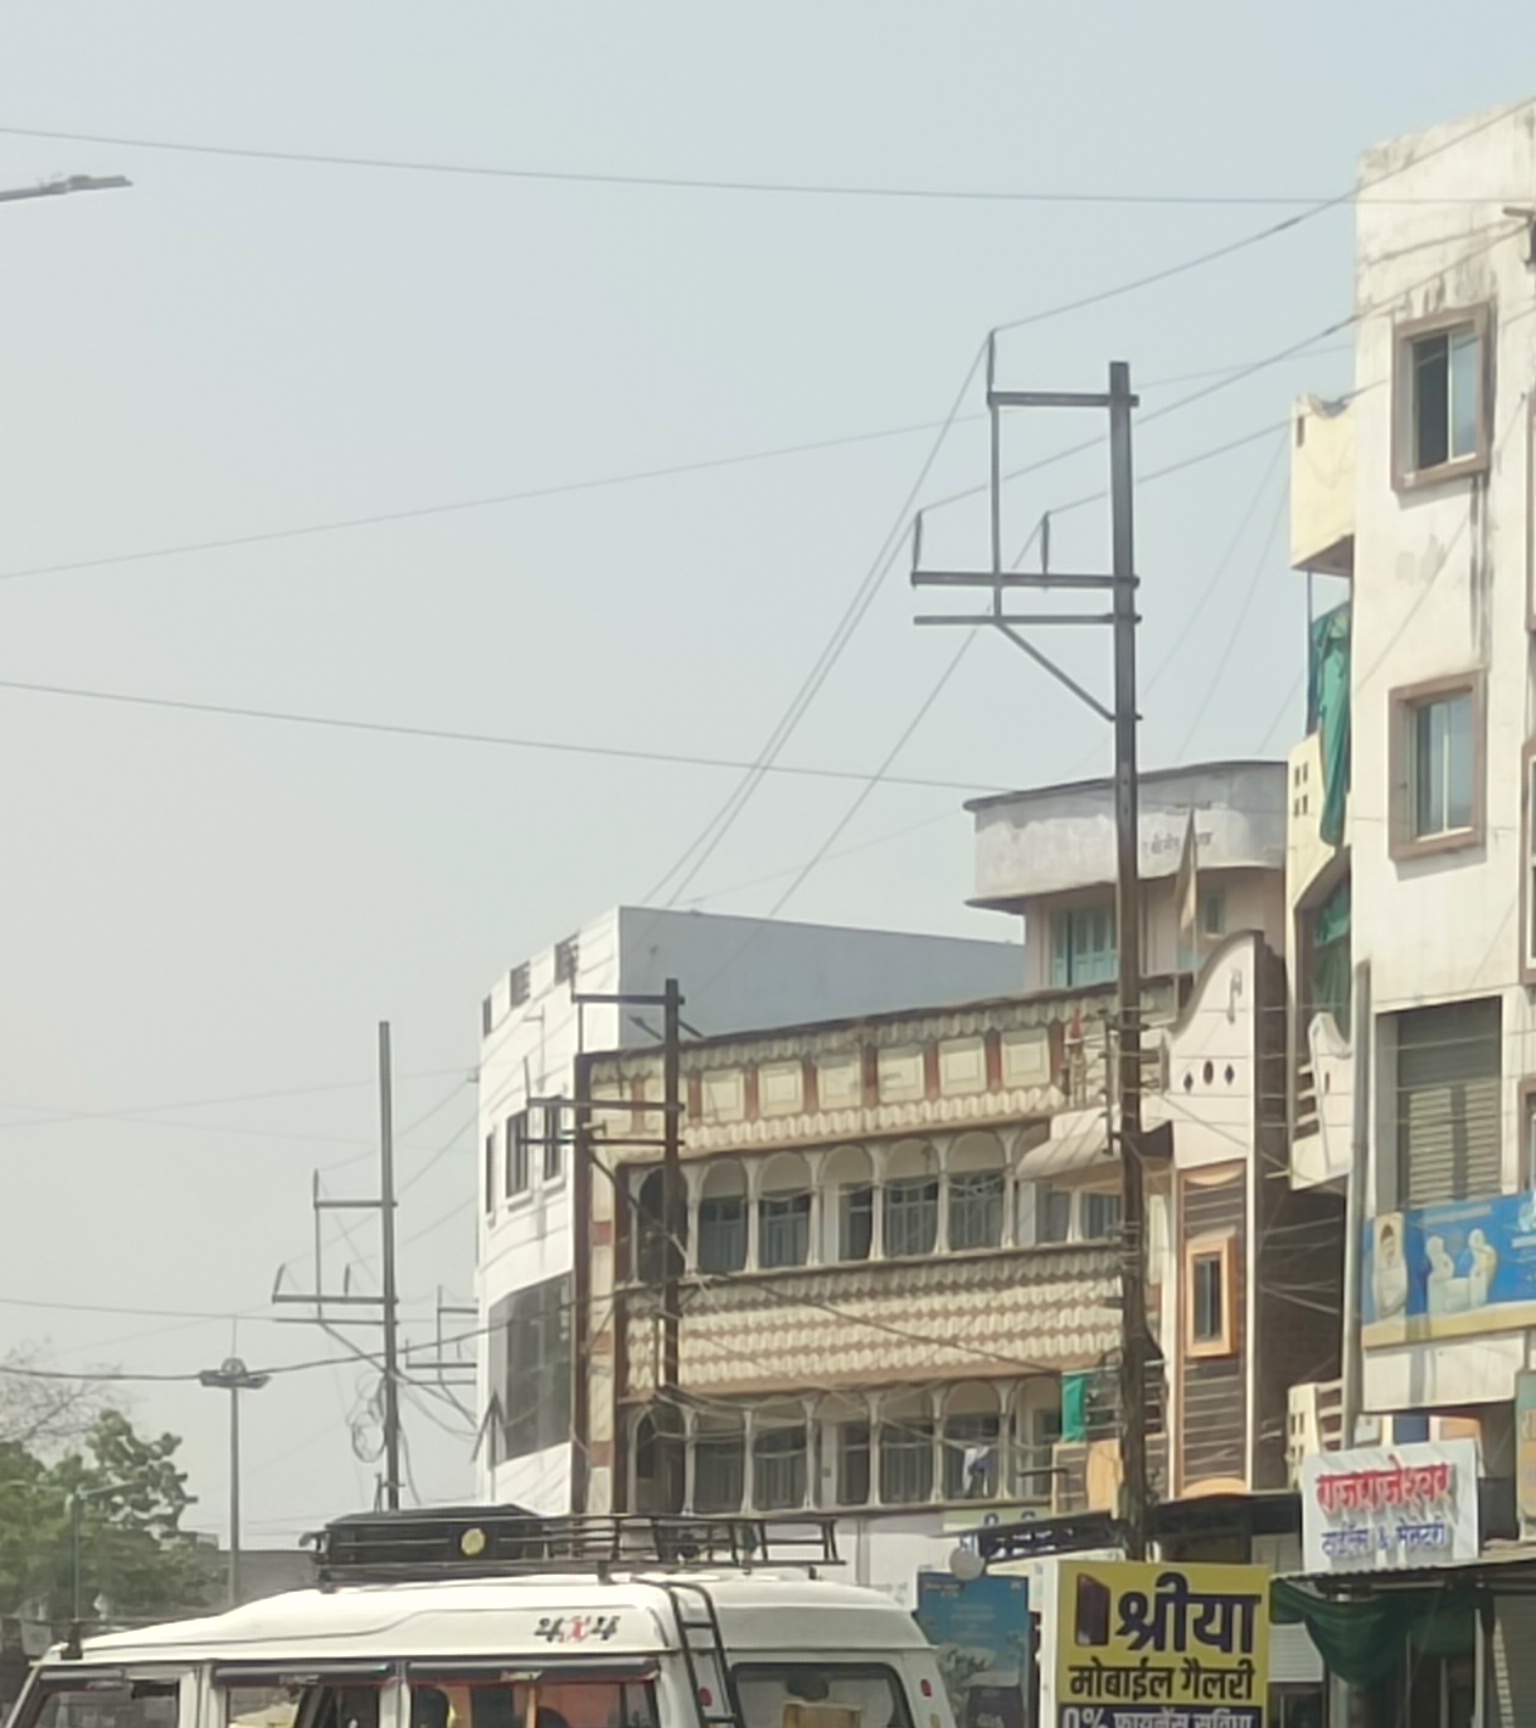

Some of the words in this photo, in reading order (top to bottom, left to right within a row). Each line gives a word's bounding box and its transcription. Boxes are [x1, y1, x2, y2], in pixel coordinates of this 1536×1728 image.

[1115, 1571, 1262, 1654] श्रीया
[1068, 1656, 1175, 1701] मोबाईल
[1180, 1657, 1256, 1701] गैलरी
